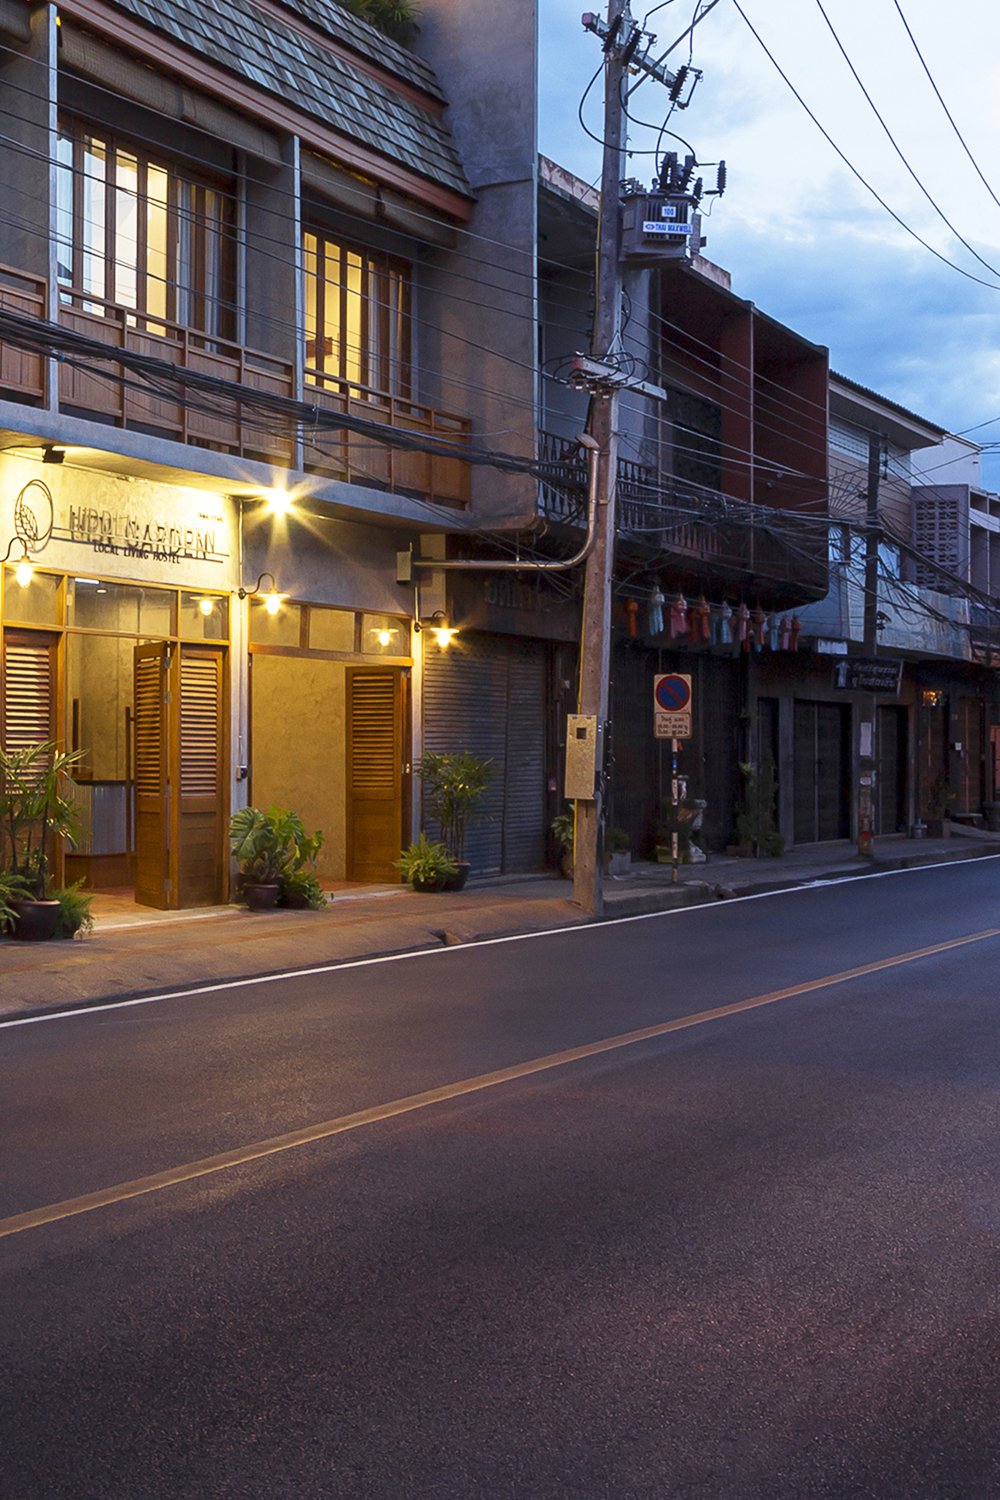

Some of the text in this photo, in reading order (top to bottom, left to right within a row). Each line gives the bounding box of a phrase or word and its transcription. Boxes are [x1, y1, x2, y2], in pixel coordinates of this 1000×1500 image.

[655, 223, 692, 233] THAI MAXWELL
[69, 504, 138, 540] HIDDEN
[93, 541, 182, 565] LOCAL LIVING HOSTEL
